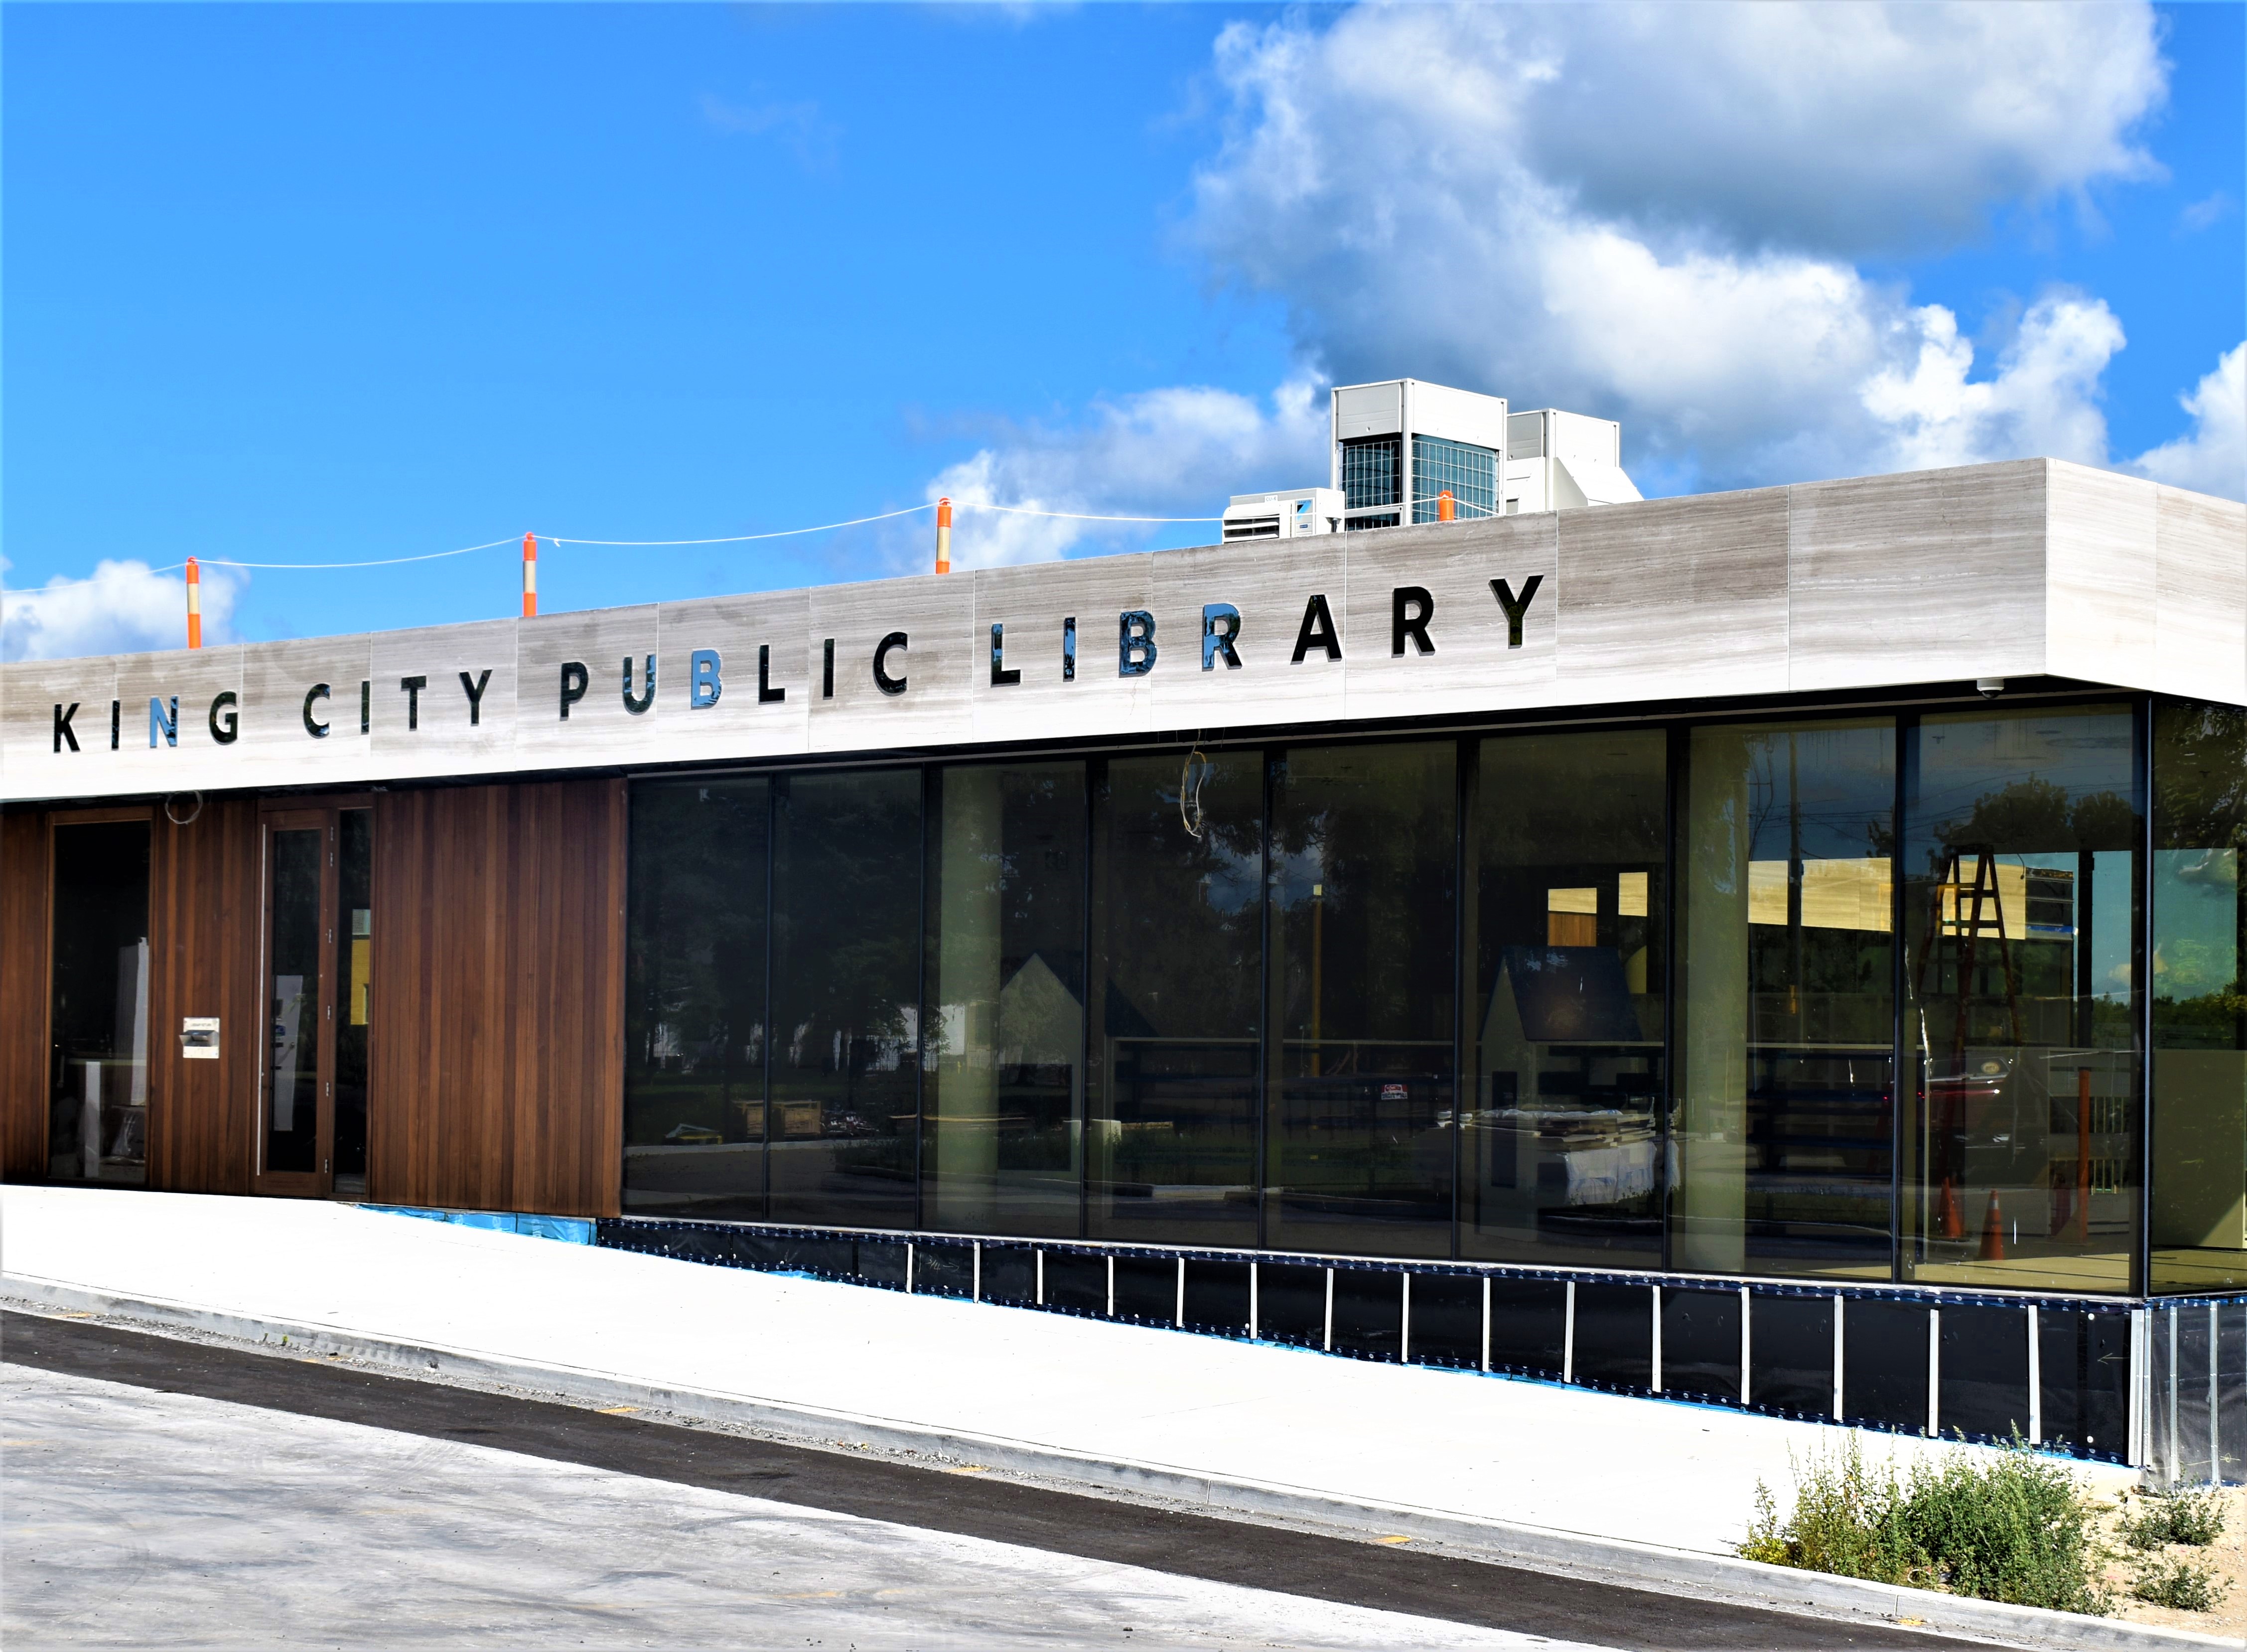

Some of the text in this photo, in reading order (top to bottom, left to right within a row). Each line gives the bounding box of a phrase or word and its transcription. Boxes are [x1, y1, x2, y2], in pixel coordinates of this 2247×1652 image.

[53, 574, 1545, 754] KING CITY PUBLIC LIBRARY
